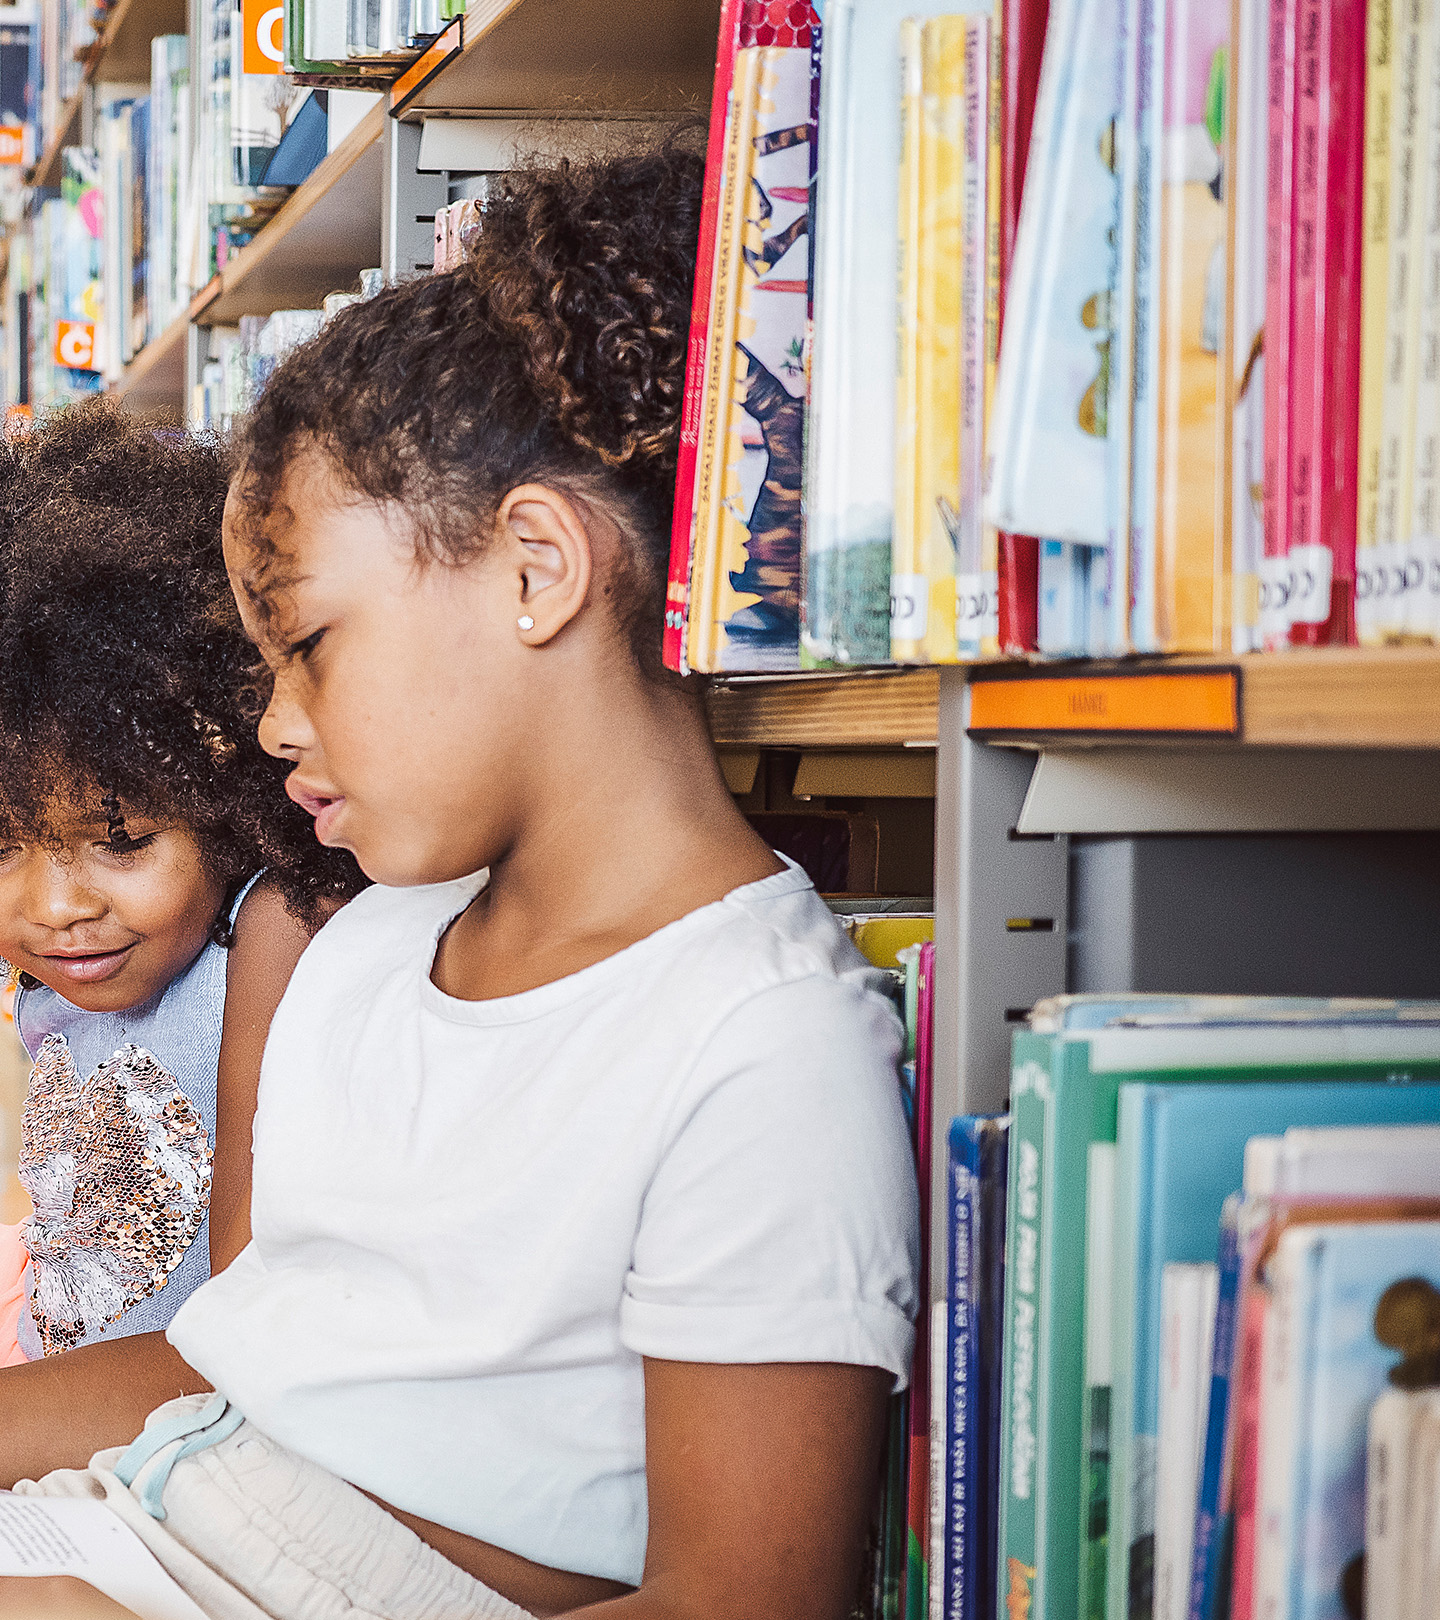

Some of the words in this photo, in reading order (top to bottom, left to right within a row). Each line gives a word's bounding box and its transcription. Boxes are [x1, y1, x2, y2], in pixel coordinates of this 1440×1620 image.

[731, 99, 741, 145] NOGE
[725, 152, 738, 206] DOLGE
[723, 212, 731, 229] IN
[719, 238, 730, 278] VRAT
